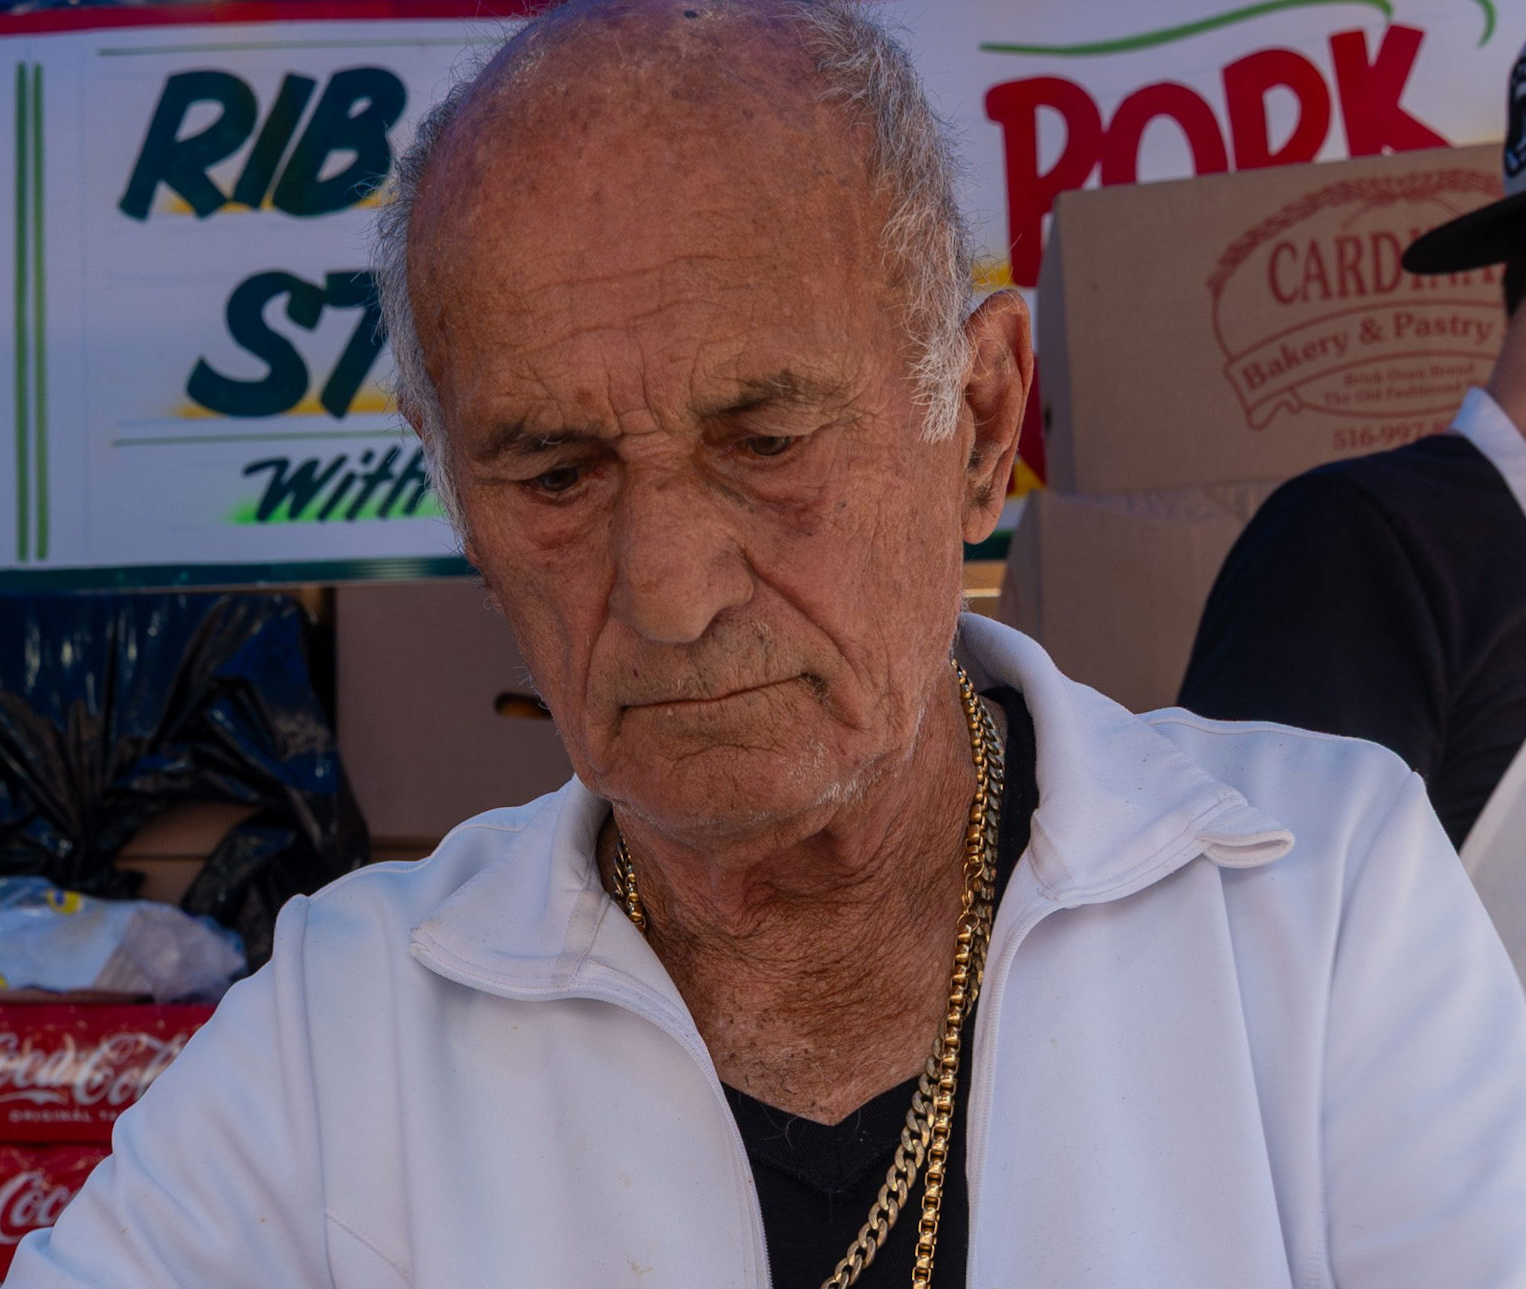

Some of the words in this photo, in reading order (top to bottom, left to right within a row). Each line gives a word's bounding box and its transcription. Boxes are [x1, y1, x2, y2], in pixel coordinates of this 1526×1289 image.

[1241, 331, 1350, 391] Bakery
[1359, 317, 1384, 346] &
[1393, 311, 1494, 346] Pastry
[8, 1108, 93, 1124] ORIGINAL
